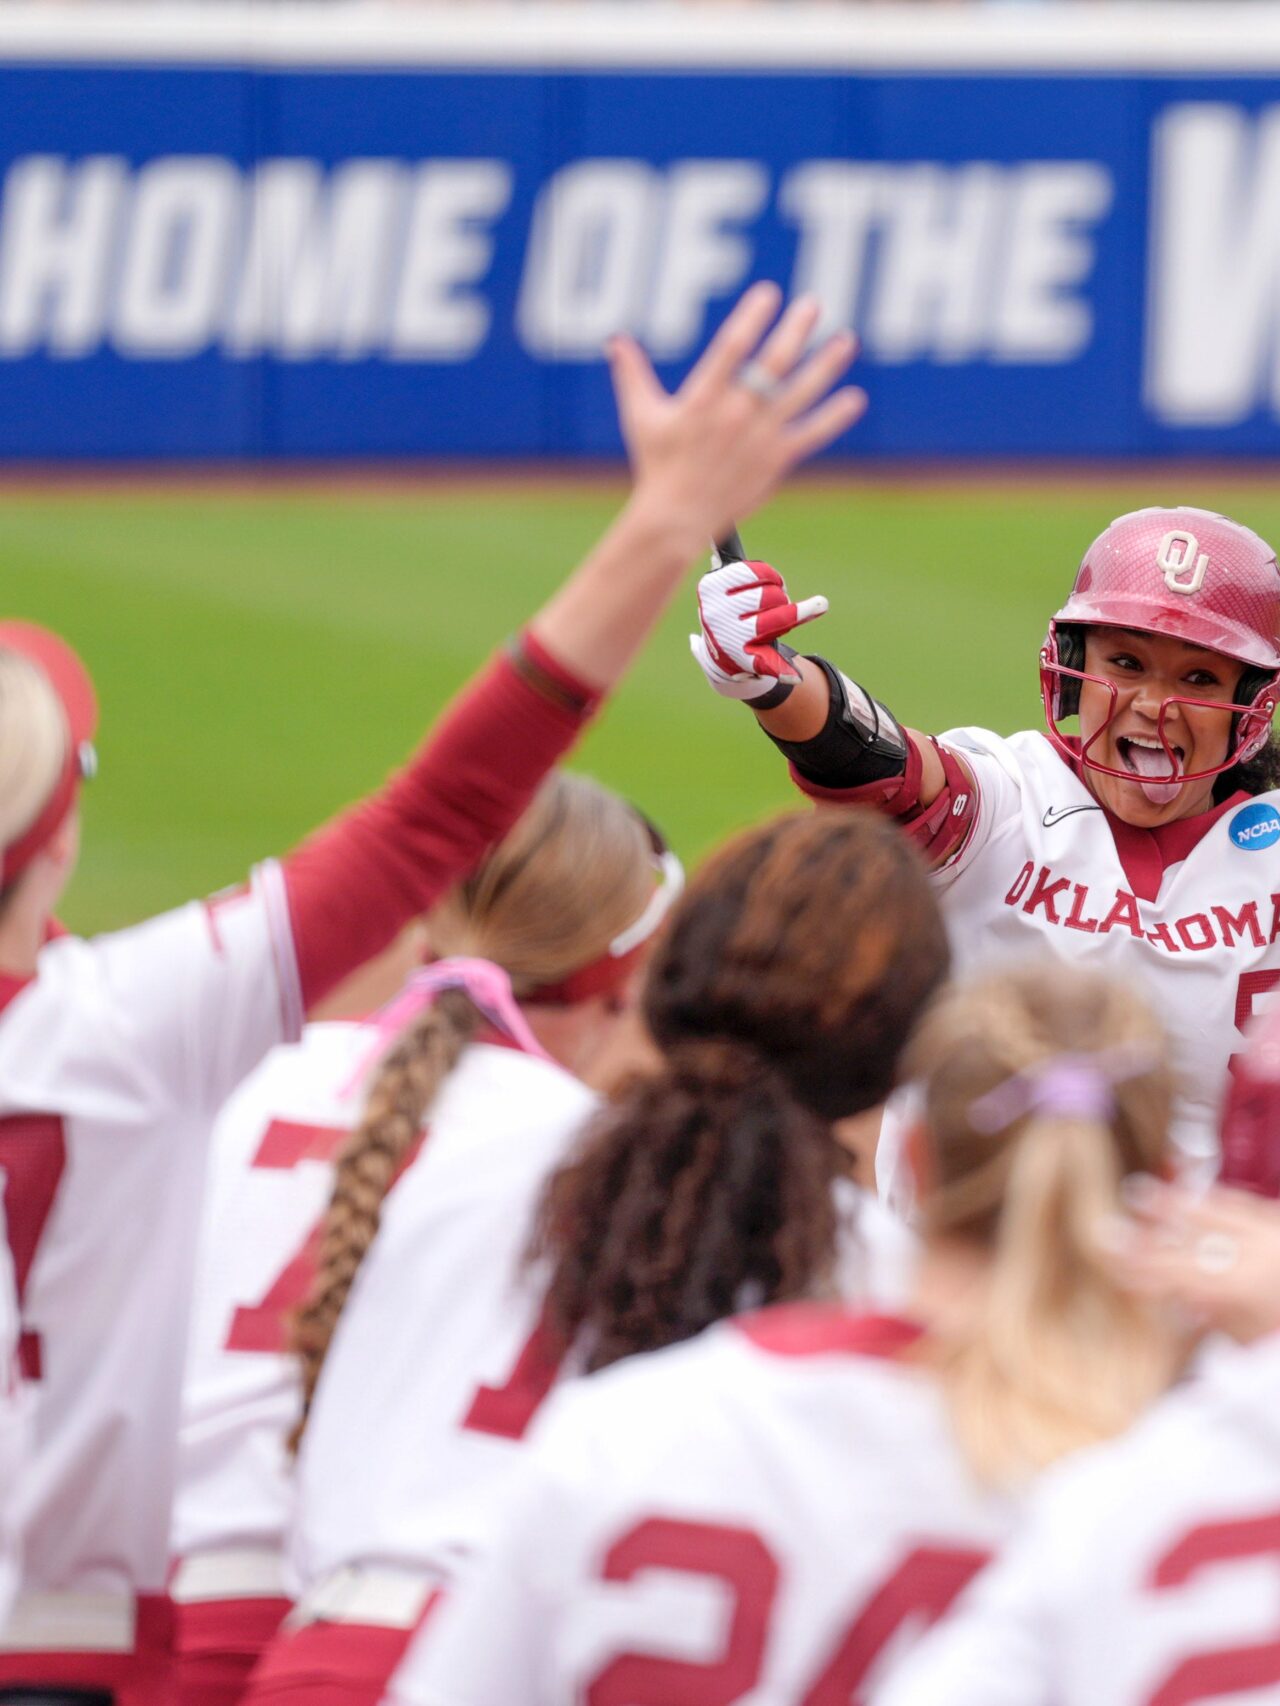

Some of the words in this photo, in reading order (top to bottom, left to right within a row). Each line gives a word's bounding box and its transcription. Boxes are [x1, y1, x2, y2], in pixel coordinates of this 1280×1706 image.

[0, 157, 510, 360] HOME
[516, 160, 773, 362] OF
[780, 161, 1111, 363] THE
[1156, 530, 1209, 595] OU
[1237, 819, 1280, 843] NCAA
